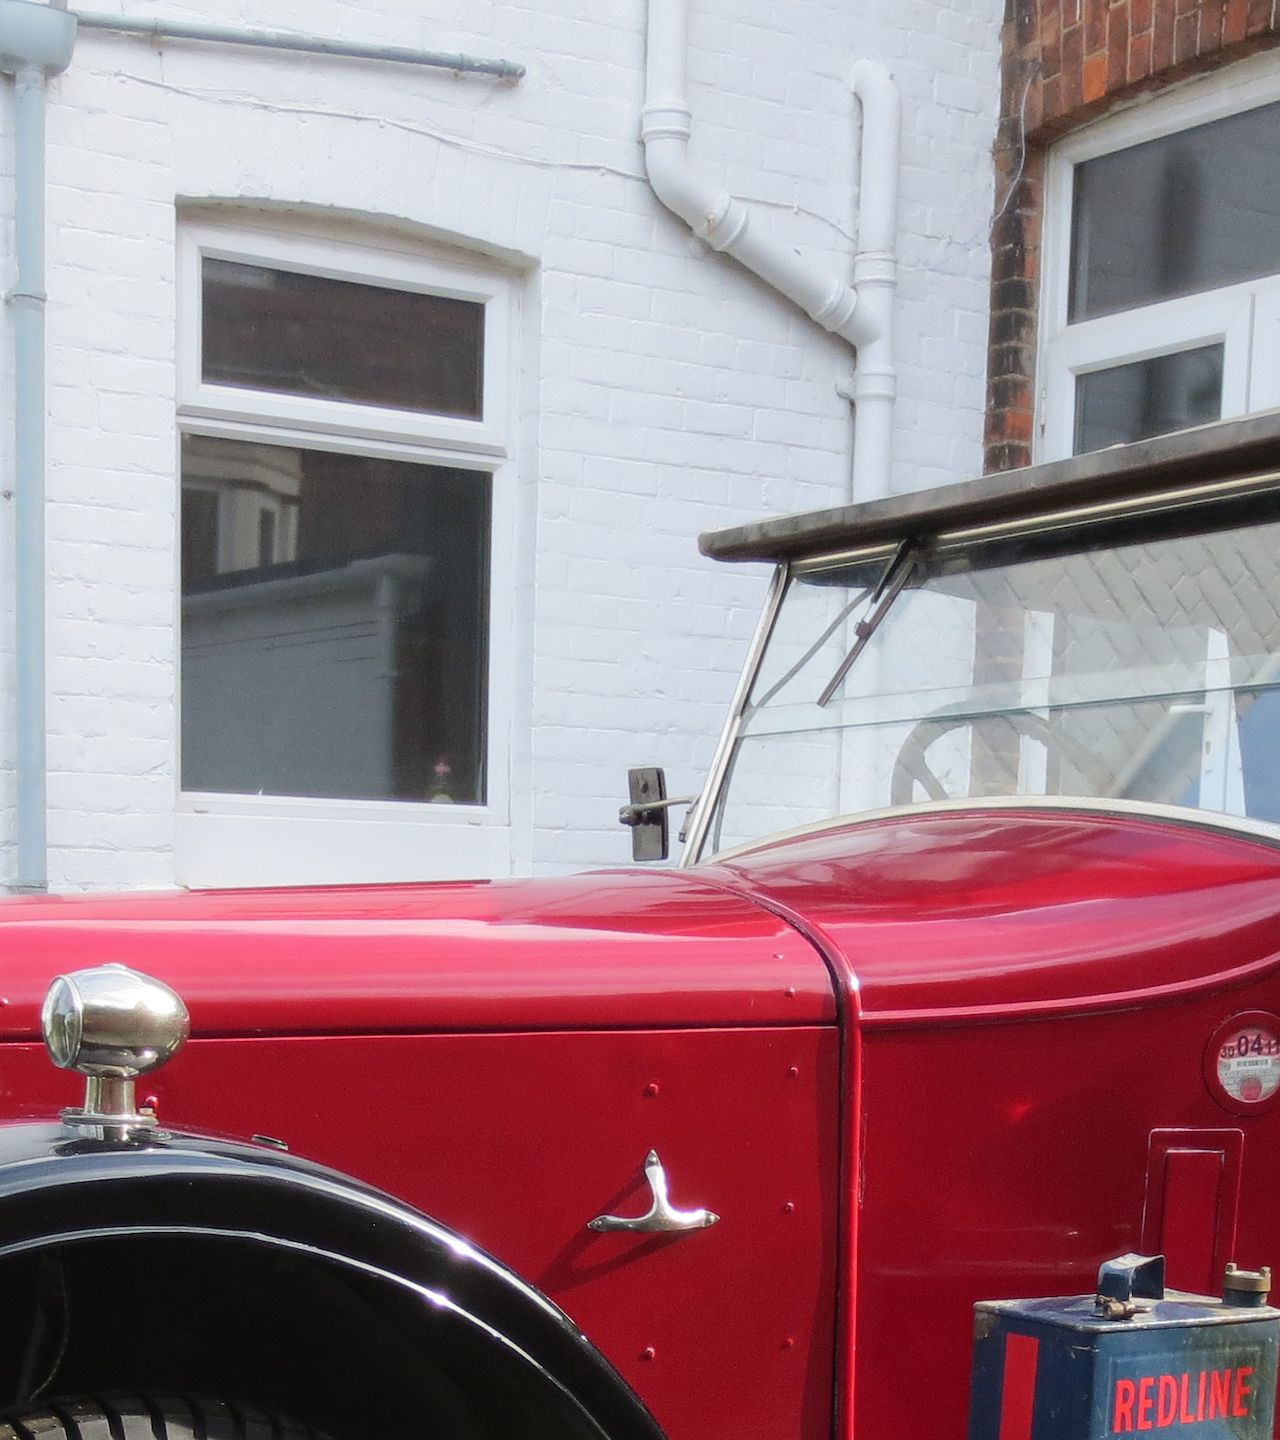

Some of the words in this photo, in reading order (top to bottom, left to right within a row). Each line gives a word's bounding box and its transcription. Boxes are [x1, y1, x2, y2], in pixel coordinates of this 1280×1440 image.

[1220, 1046, 1234, 1058] 30
[1237, 1034, 1263, 1057] 04
[1112, 1366, 1255, 1433] REDLINE
